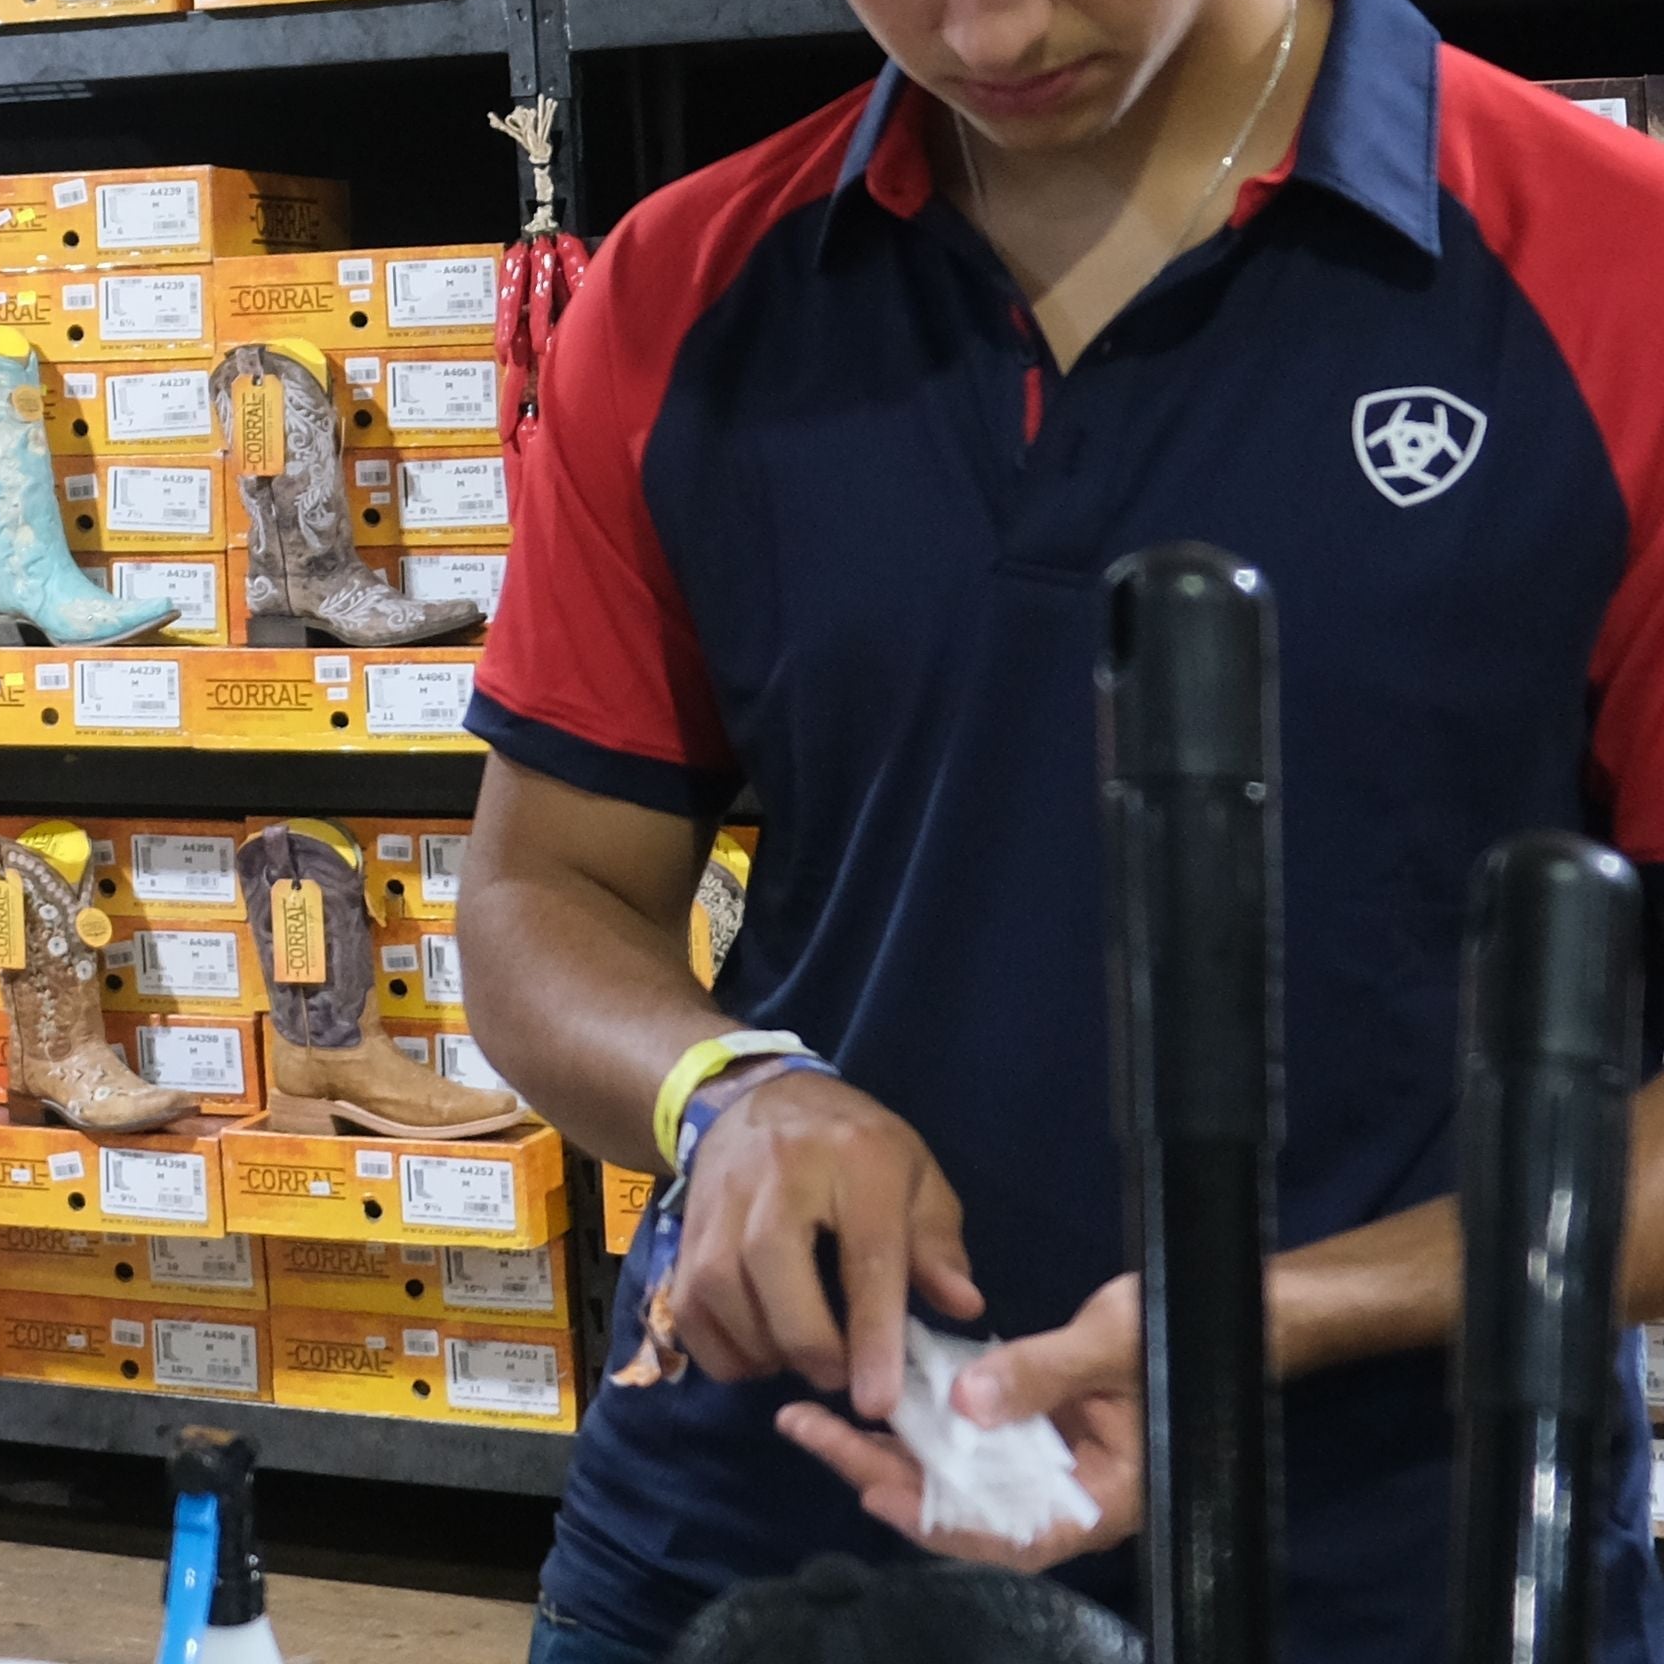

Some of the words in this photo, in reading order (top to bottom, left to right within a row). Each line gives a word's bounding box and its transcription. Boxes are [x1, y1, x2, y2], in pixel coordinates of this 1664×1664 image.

[238, 288, 329, 312] CORRAL
[245, 398, 265, 468] CORRAL
[214, 683, 308, 706] CORRAL
[286, 894, 307, 975] CORRAL
[295, 1345, 387, 1373] CORRAL
